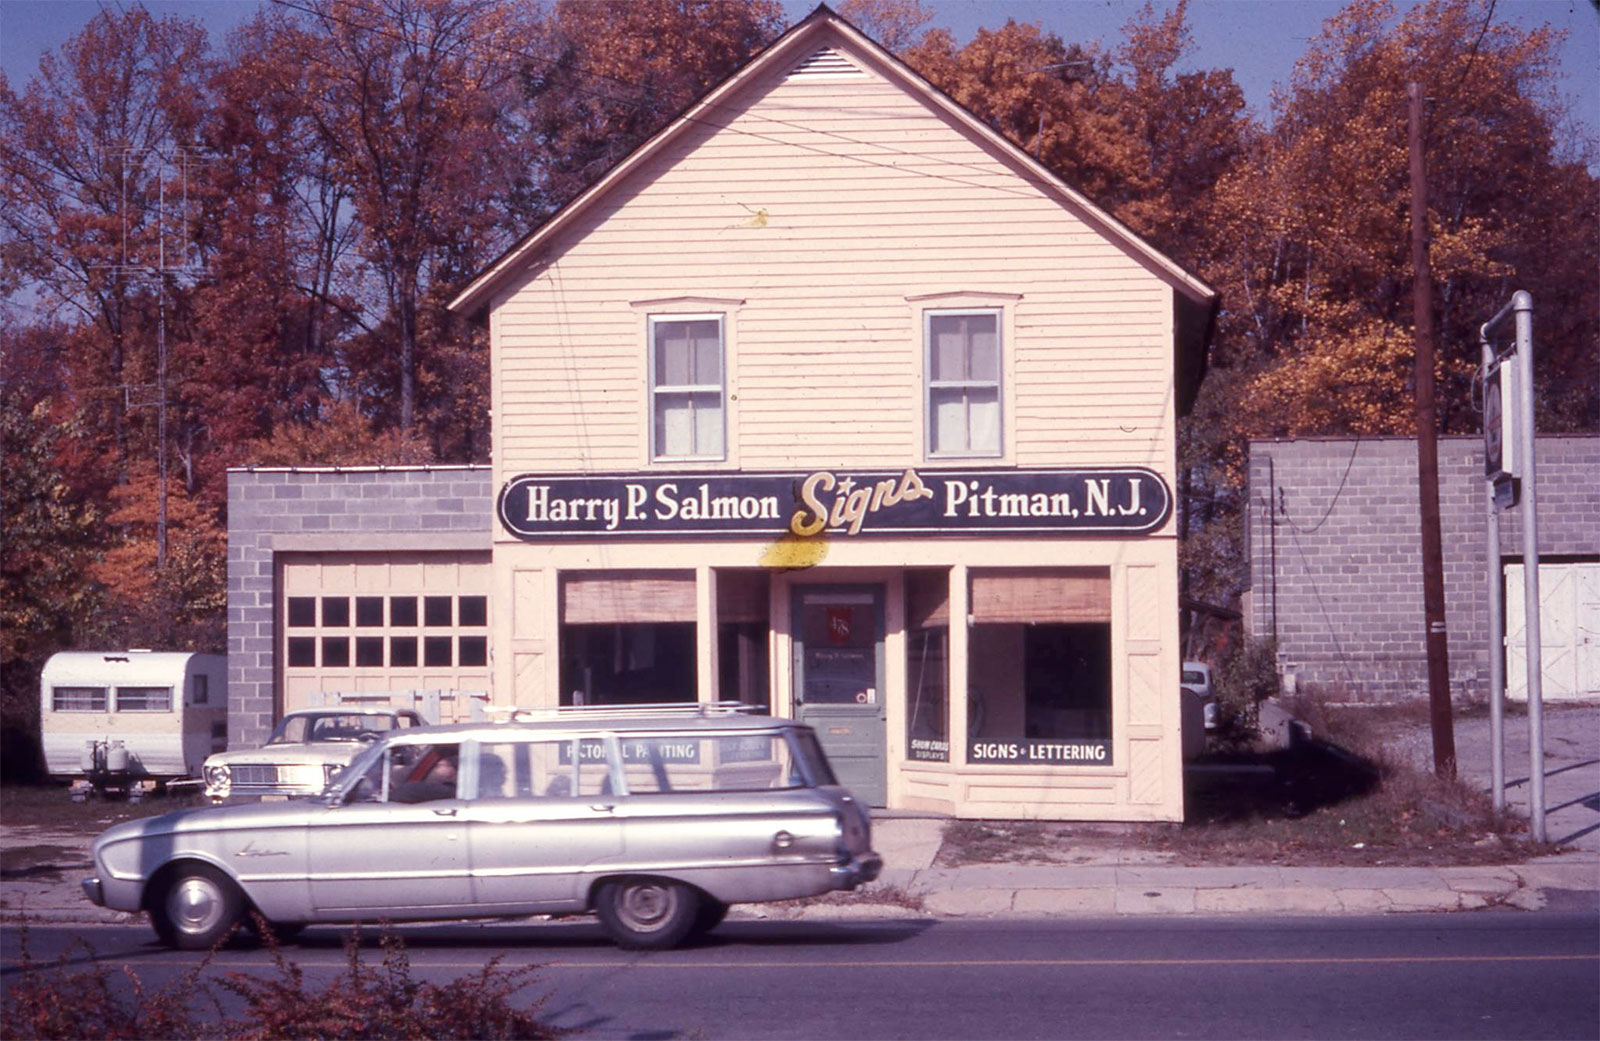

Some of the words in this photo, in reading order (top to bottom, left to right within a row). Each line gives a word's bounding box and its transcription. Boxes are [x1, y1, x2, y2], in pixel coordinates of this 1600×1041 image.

[525, 485, 620, 530] Harry
[625, 483, 648, 520] P.
[654, 483, 781, 521] Salmon
[790, 468, 934, 536] Signs
[943, 479, 1079, 519] Pitman,
[1084, 478, 1147, 516] N.J.
[915, 750, 945, 760] DISPLAYS
[973, 743, 1018, 759] SIGNS
[1029, 744, 1106, 760] LETTERING
